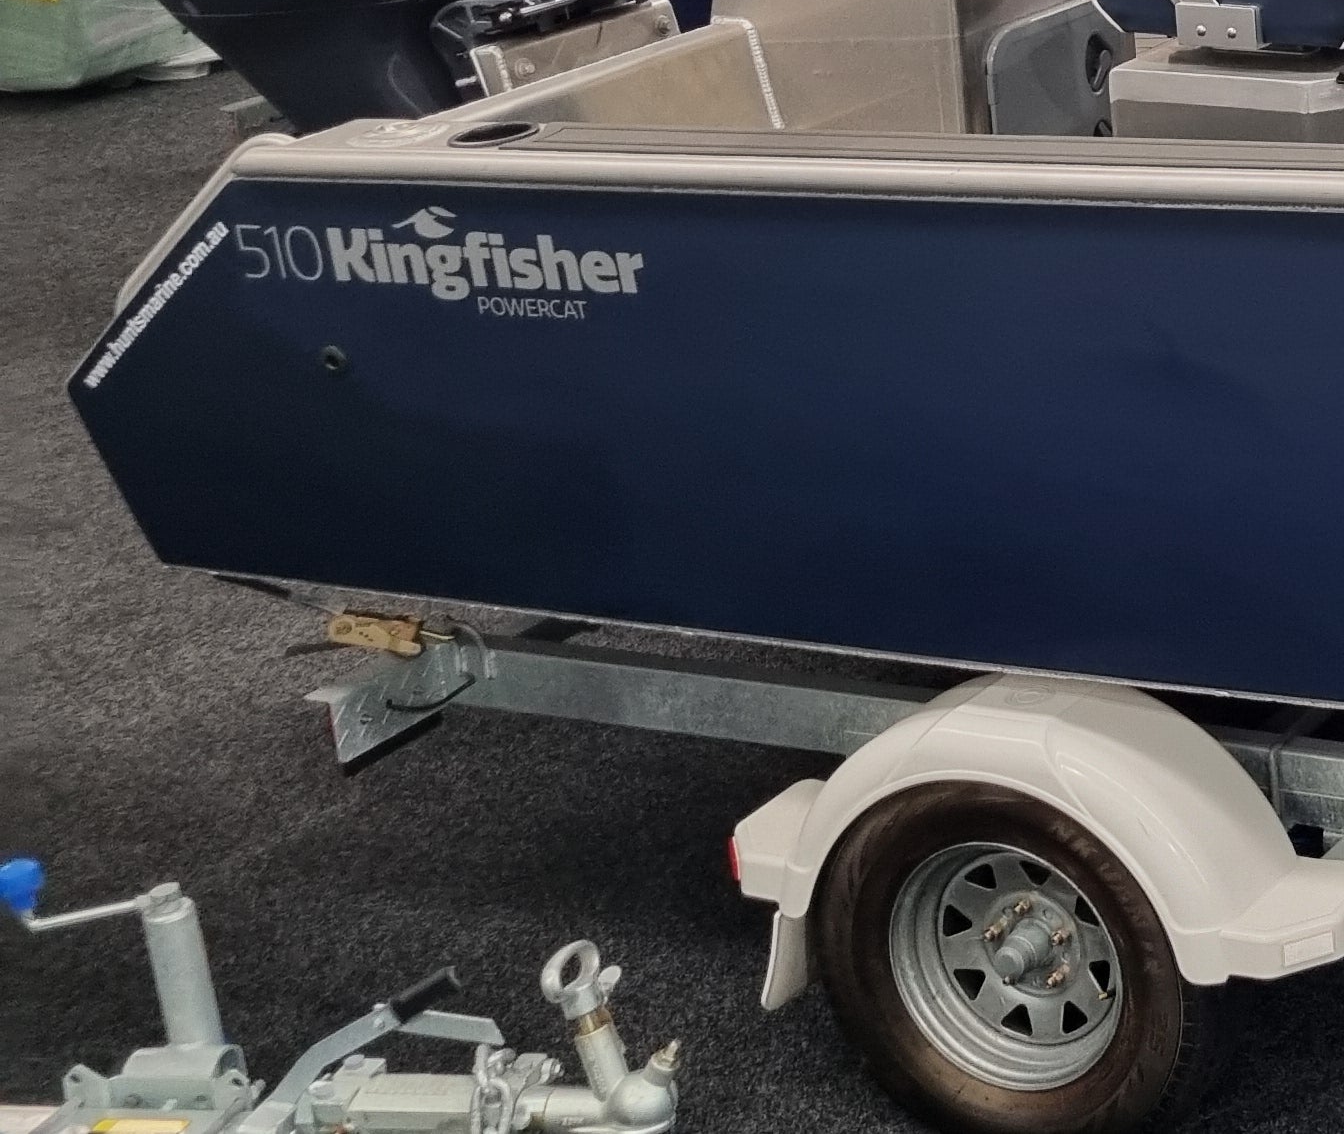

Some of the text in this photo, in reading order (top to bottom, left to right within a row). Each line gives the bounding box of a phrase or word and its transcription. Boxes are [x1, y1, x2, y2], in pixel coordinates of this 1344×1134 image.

[235, 224, 644, 301] 510 Kingfisher
[82, 220, 231, 390] www.huntsmarine.com.au
[476, 296, 589, 321] POWERCAT
